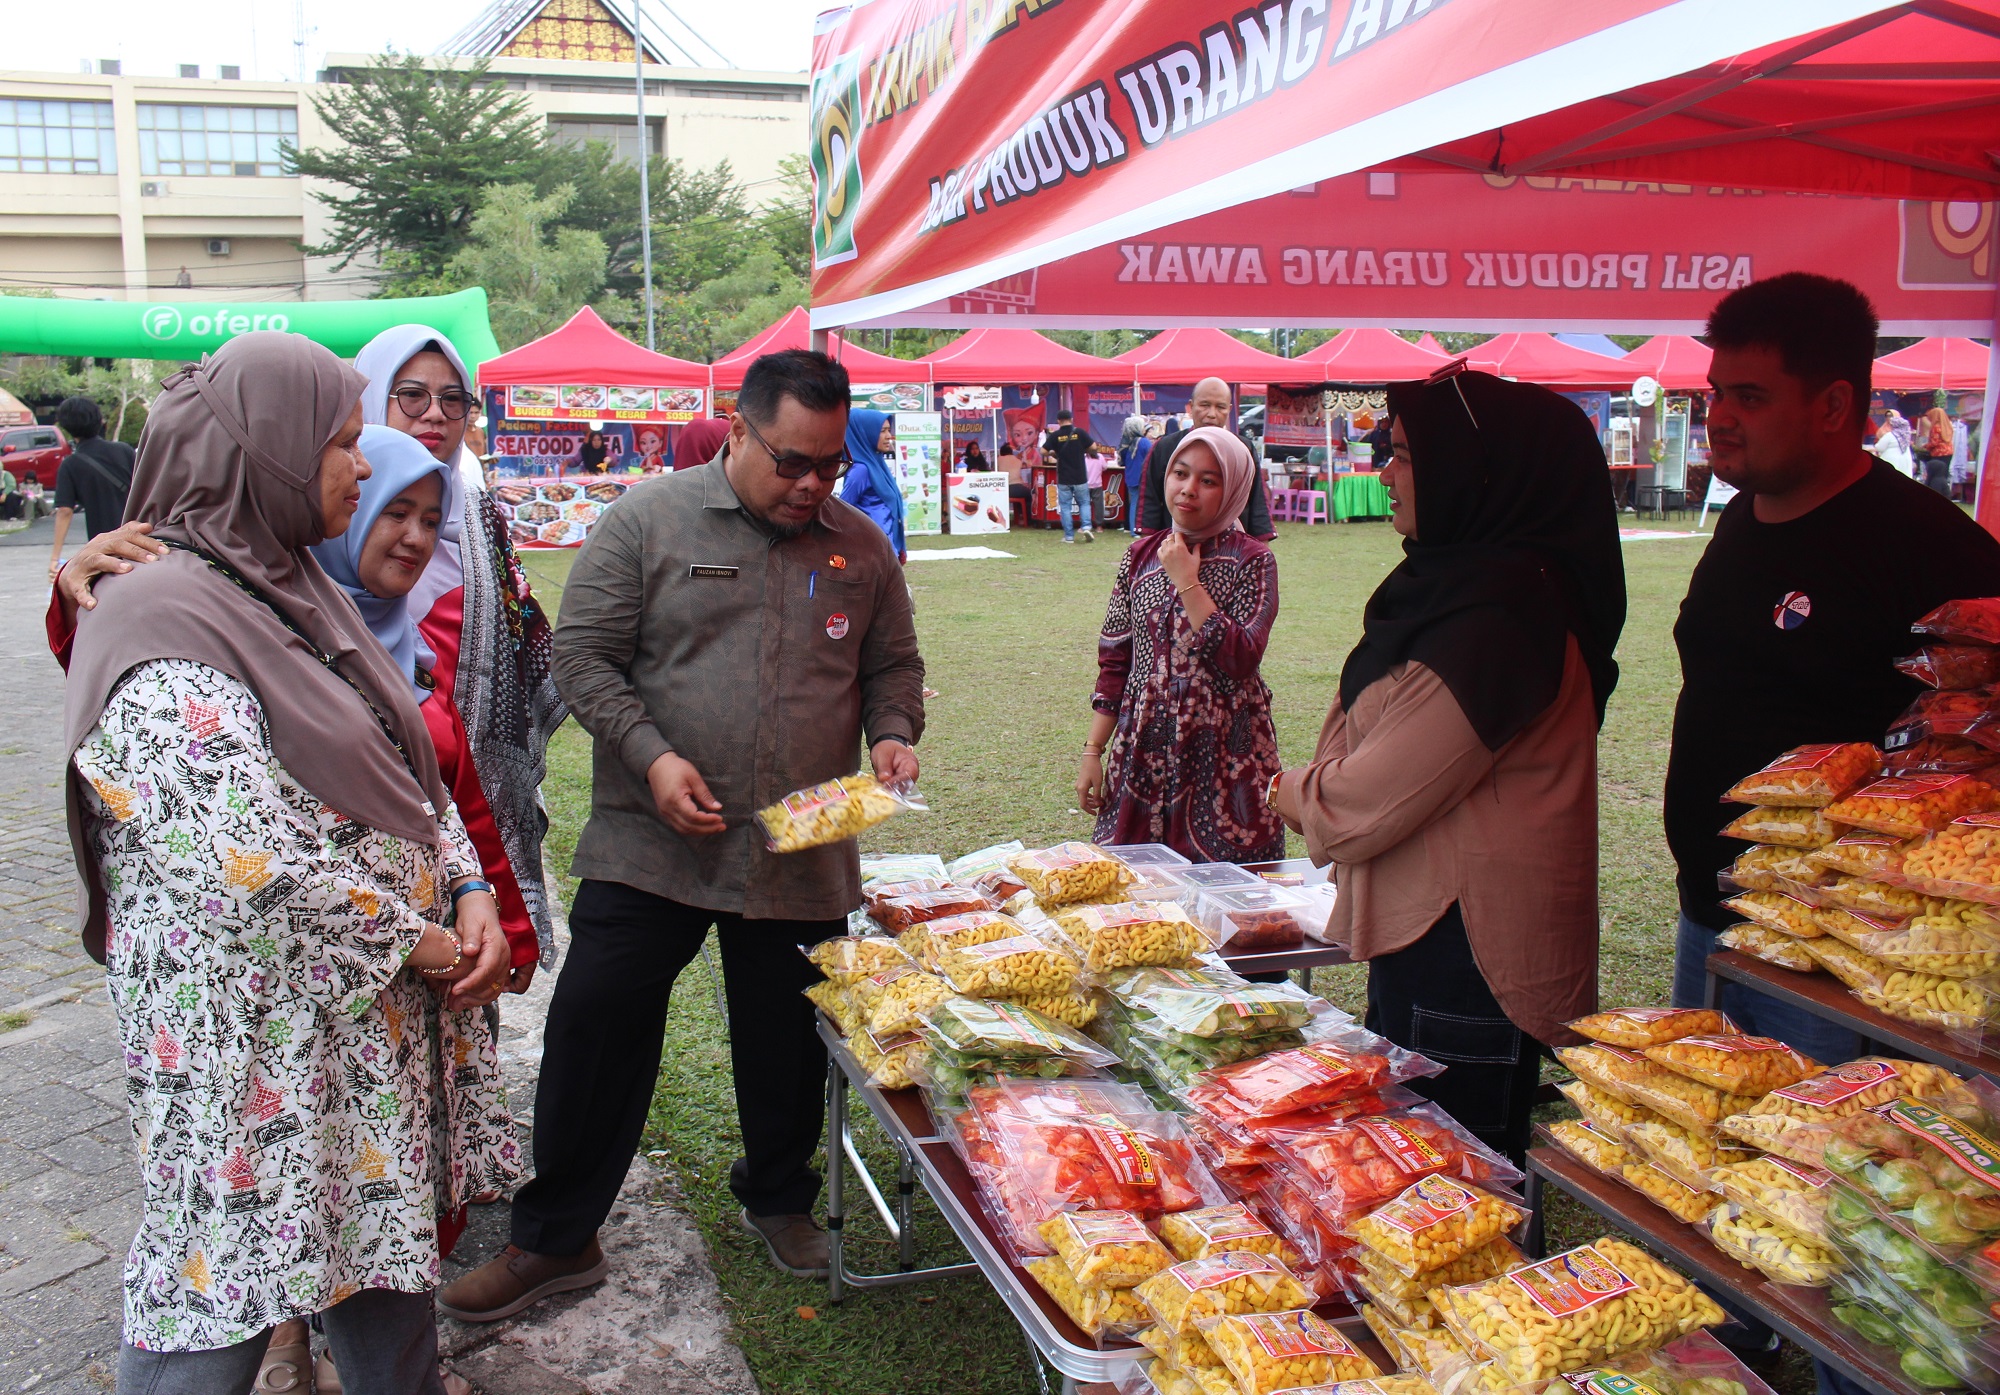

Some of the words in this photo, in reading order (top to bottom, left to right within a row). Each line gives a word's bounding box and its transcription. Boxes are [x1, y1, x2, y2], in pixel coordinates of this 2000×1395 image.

[973, 86, 1126, 211] PRODUK
[1118, 0, 1326, 145] URANG
[189, 310, 290, 336] ofero
[514, 407, 554, 417] BURGER
[568, 408, 598, 418] SOSIS
[615, 410, 647, 420] KEBAB
[665, 411, 694, 421] SOSIS
[497, 420, 542, 433] Padang
[943, 422, 983, 432] SNGAPURA
[494, 435, 573, 456] SEAFOOD
[1285, 1051, 1318, 1068] Prima
[1373, 1123, 1409, 1149] Prima
[1924, 1122, 1993, 1168] Prima
